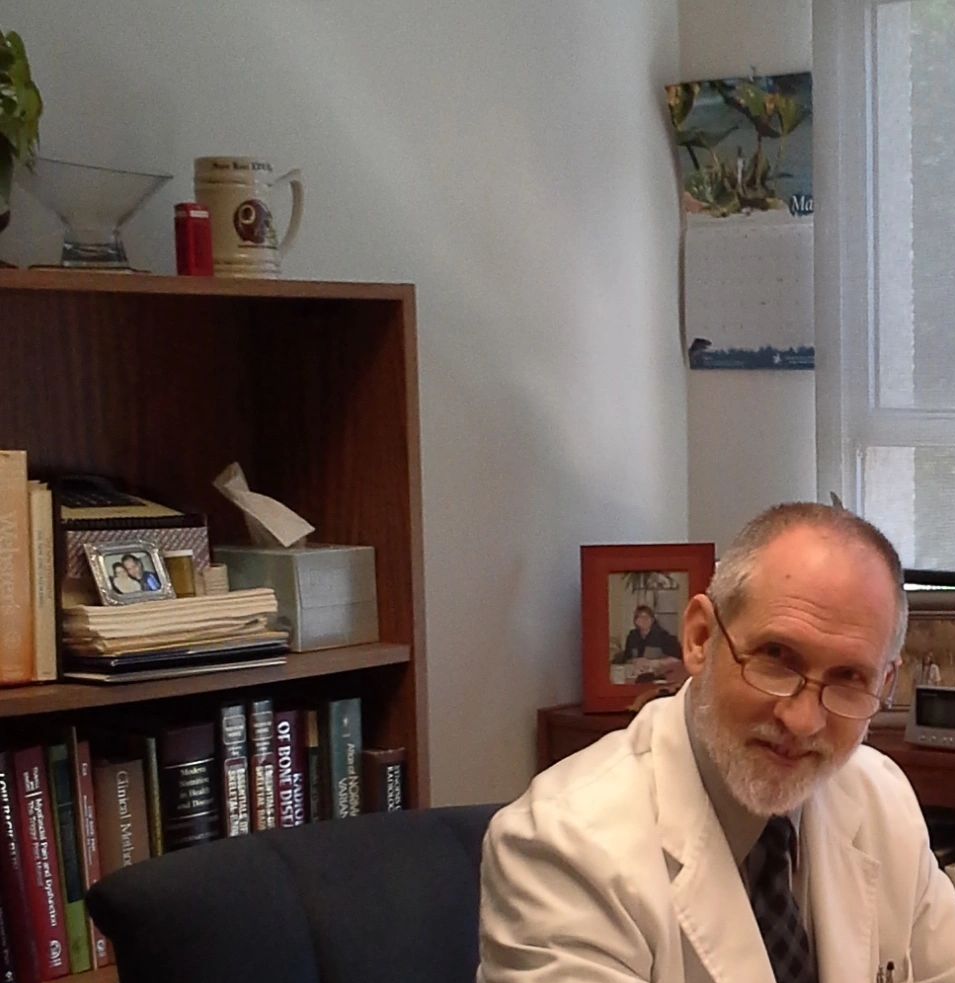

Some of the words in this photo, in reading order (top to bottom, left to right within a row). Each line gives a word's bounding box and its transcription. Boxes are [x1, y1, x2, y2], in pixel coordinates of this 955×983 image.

[277, 721, 291, 742] OF
[278, 745, 293, 787] BONE
[116, 770, 133, 820] Clinical
